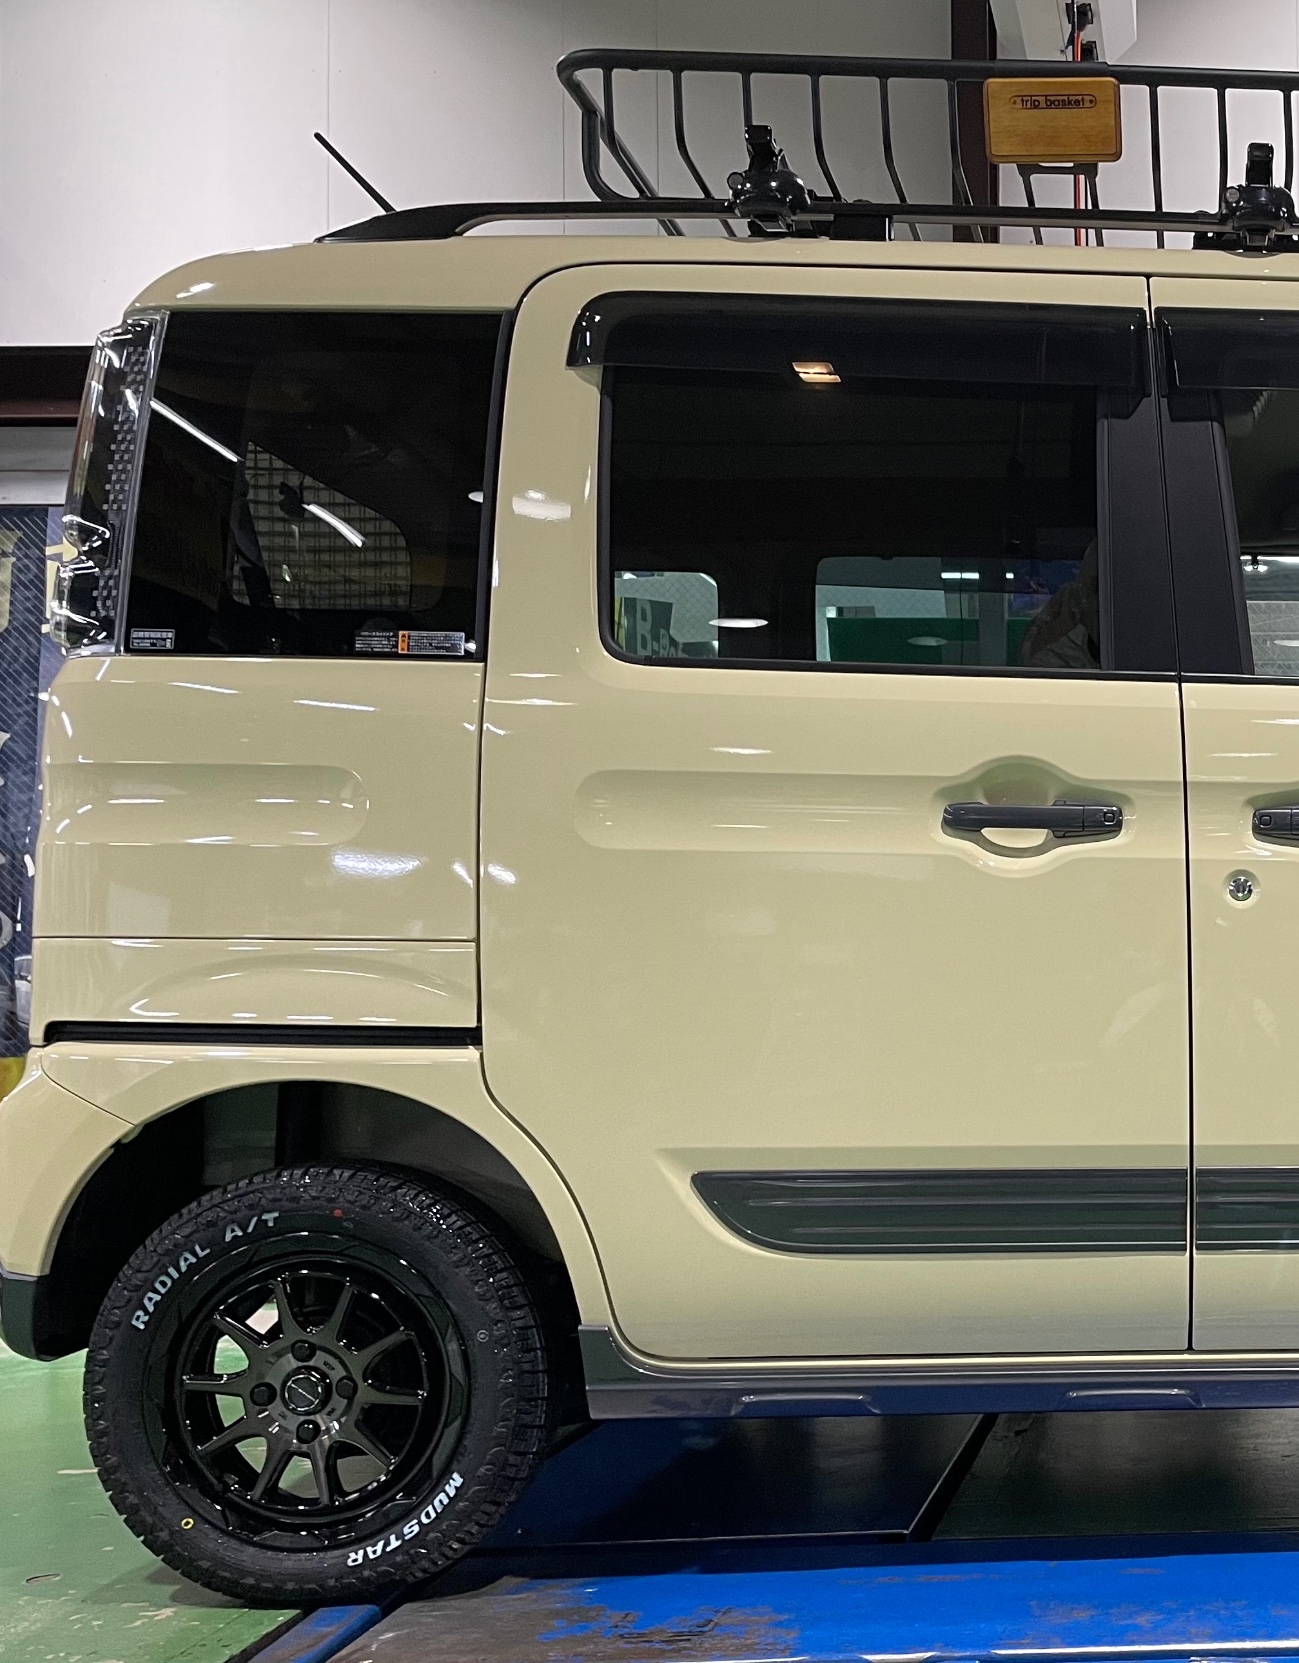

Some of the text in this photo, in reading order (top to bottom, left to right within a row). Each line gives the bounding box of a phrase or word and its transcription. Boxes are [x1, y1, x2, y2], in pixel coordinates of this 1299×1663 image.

[1021, 96, 1085, 108] trip basket
[130, 1210, 280, 1331] RADIAL A/T
[346, 1471, 464, 1567] MUDSTAR
